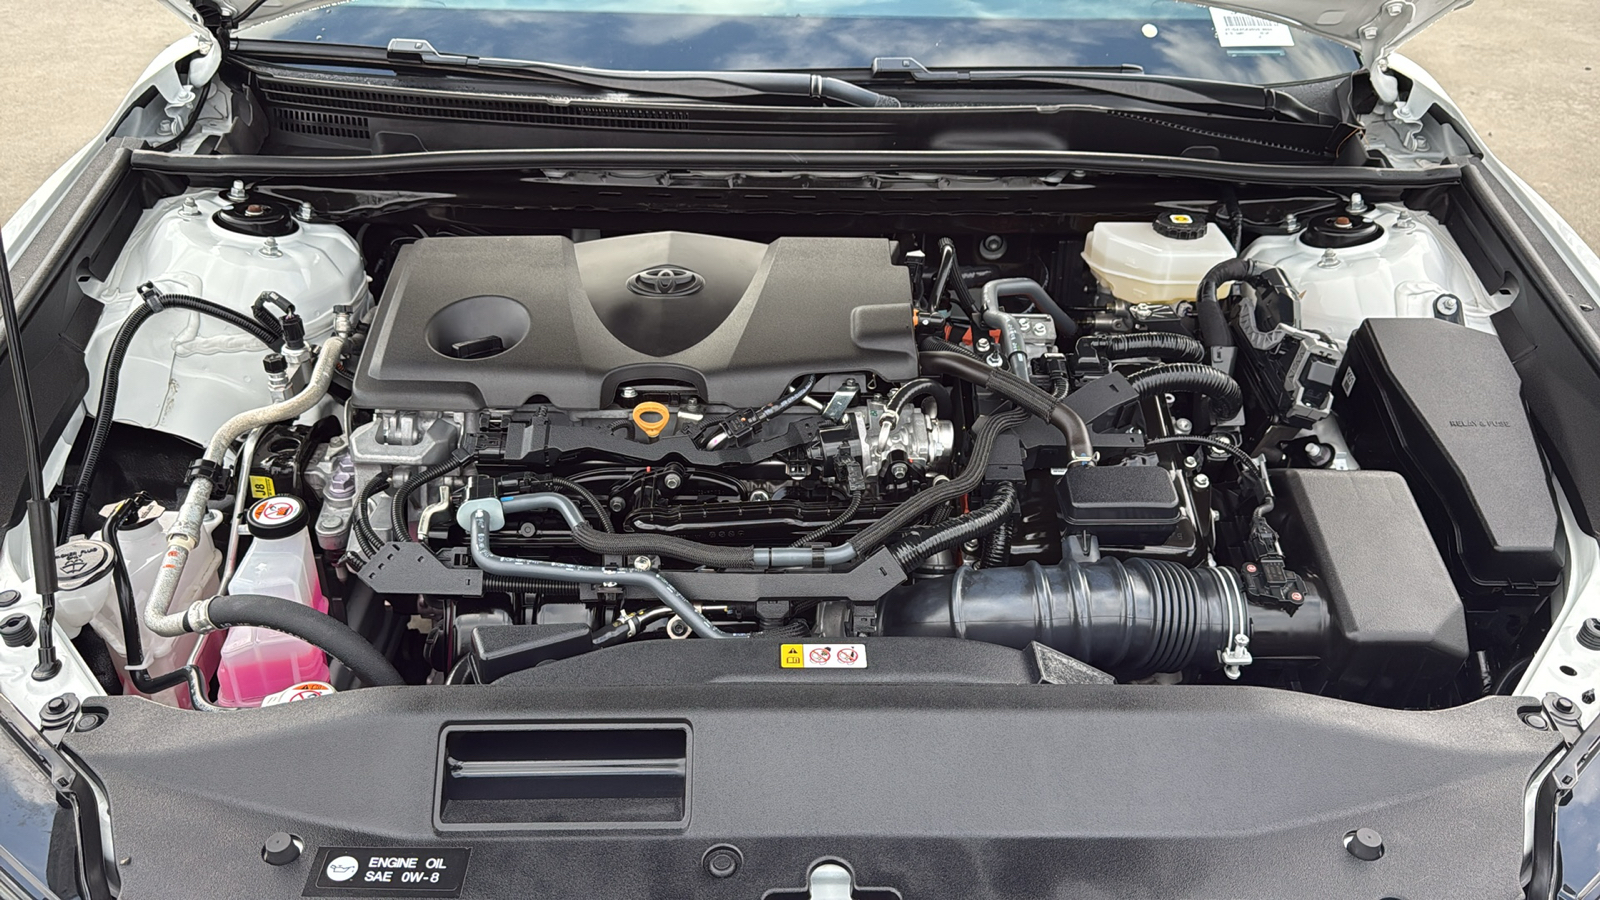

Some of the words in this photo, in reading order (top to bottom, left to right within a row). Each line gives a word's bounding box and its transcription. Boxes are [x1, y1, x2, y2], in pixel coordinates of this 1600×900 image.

[1449, 420, 1477, 428] RELAY
[255, 483, 266, 495] J8
[368, 857, 418, 869] ENGINE
[425, 857, 447, 869] OIL
[364, 871, 393, 882] SAE
[401, 871, 440, 883] 0W-8
